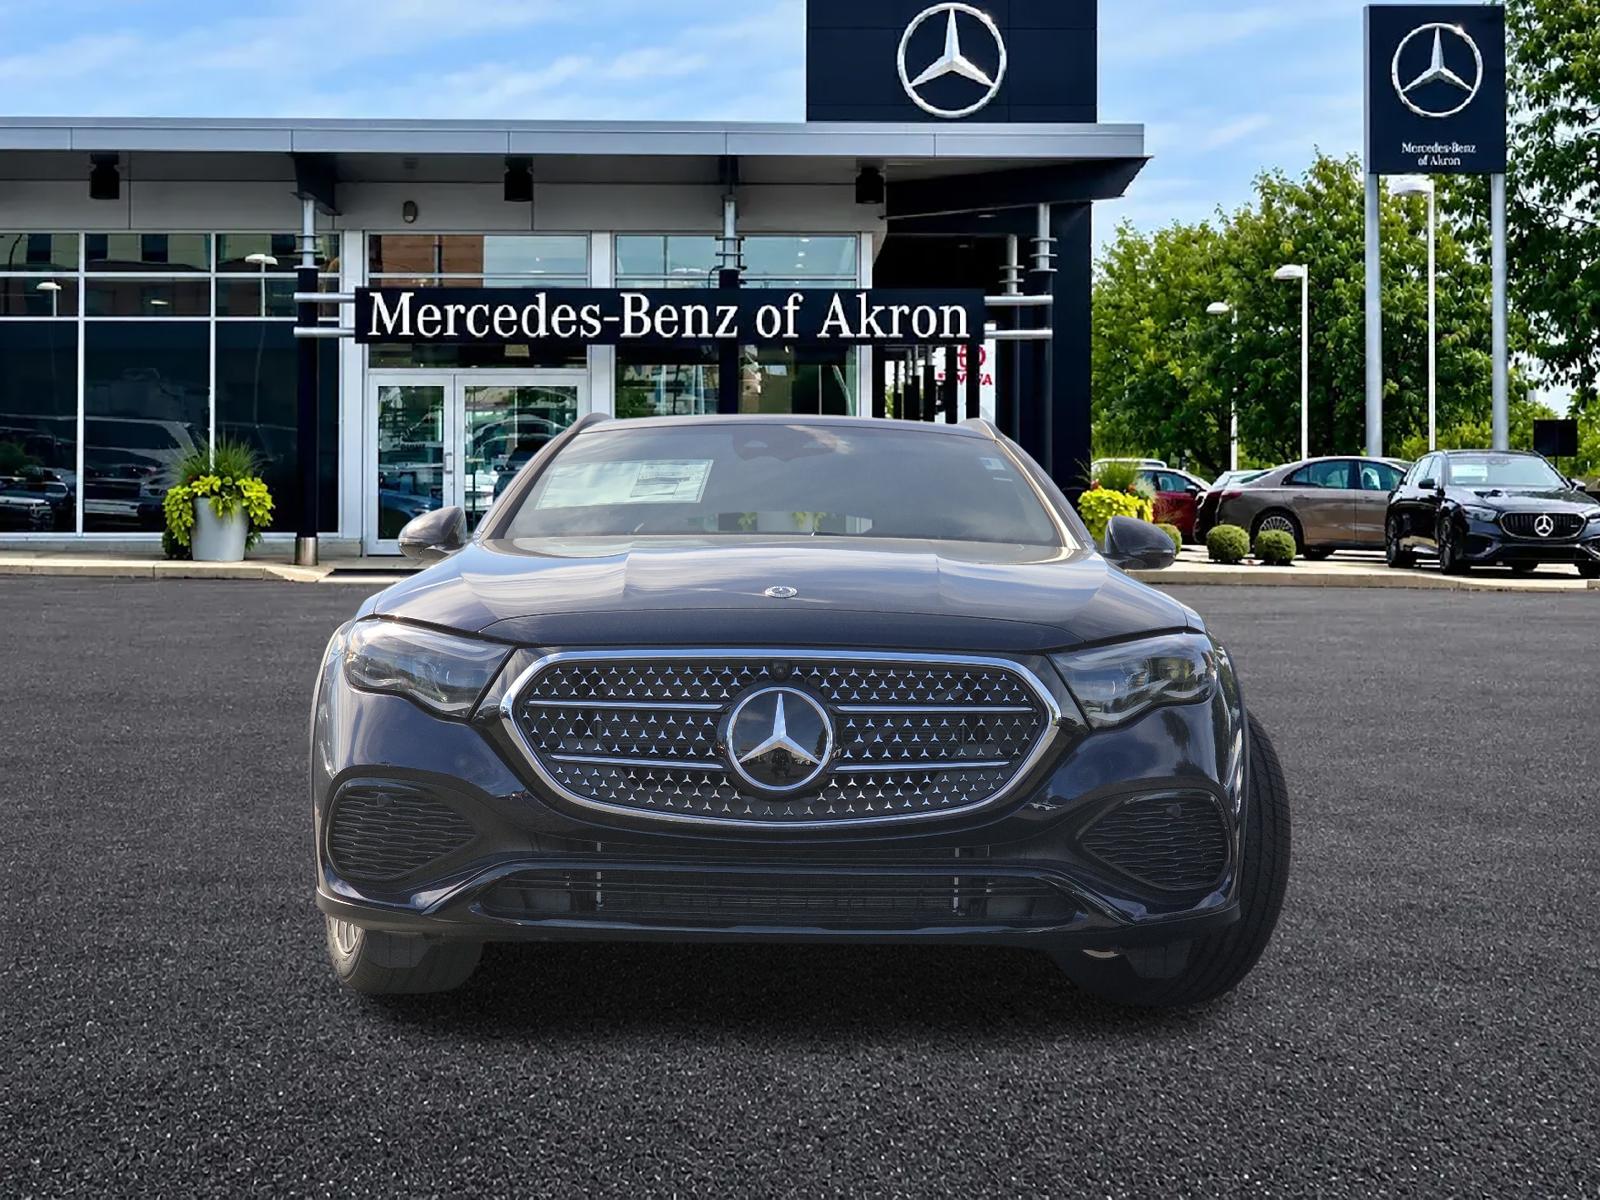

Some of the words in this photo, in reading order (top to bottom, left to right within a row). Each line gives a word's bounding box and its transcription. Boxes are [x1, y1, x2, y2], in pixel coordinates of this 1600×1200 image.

[1401, 141, 1476, 153] Mercedes-Benz
[1417, 154, 1429, 166] of
[1430, 154, 1461, 166] Akron
[367, 291, 739, 338] Mercedes-Benz
[754, 291, 804, 338] of
[816, 292, 971, 338] Akron
